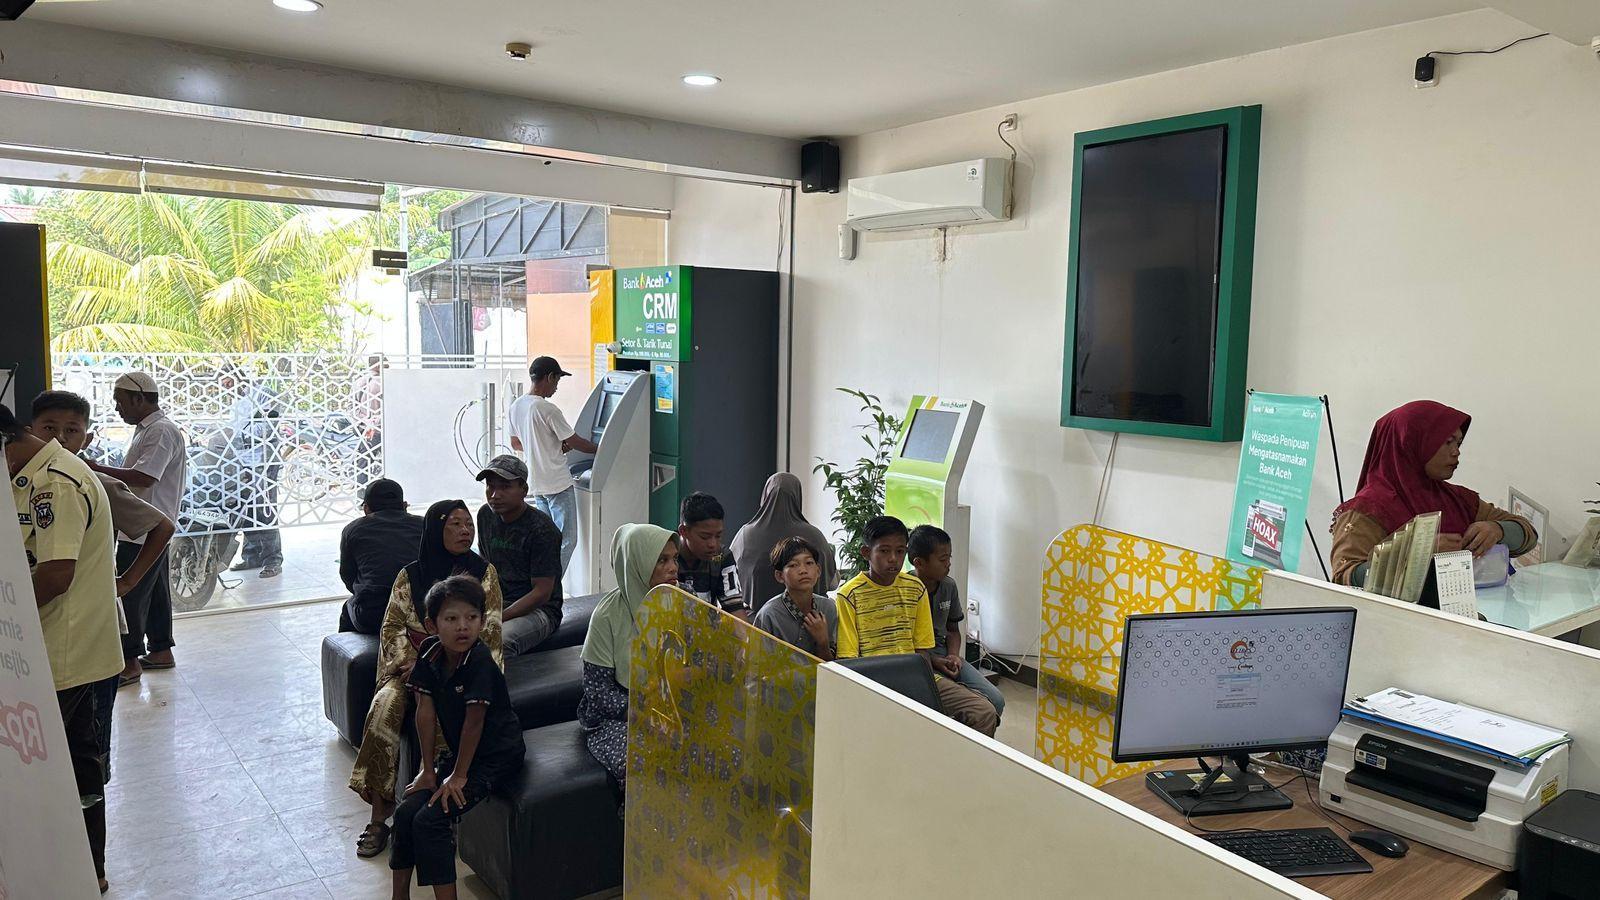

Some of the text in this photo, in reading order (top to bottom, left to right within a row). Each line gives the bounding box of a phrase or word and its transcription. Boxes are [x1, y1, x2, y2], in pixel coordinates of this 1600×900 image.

[623, 275, 664, 289] Bank Aceh
[642, 292, 677, 320] CRM
[622, 337, 636, 348] Setor
[643, 338, 656, 349] Tarik
[657, 339, 672, 350] Tunai
[1251, 430, 1309, 450] Waspada Penipuan
[1248, 444, 1307, 467] Mengatasnamakan
[1259, 462, 1292, 480] Bank Aceh
[1253, 517, 1277, 545] HOAX
